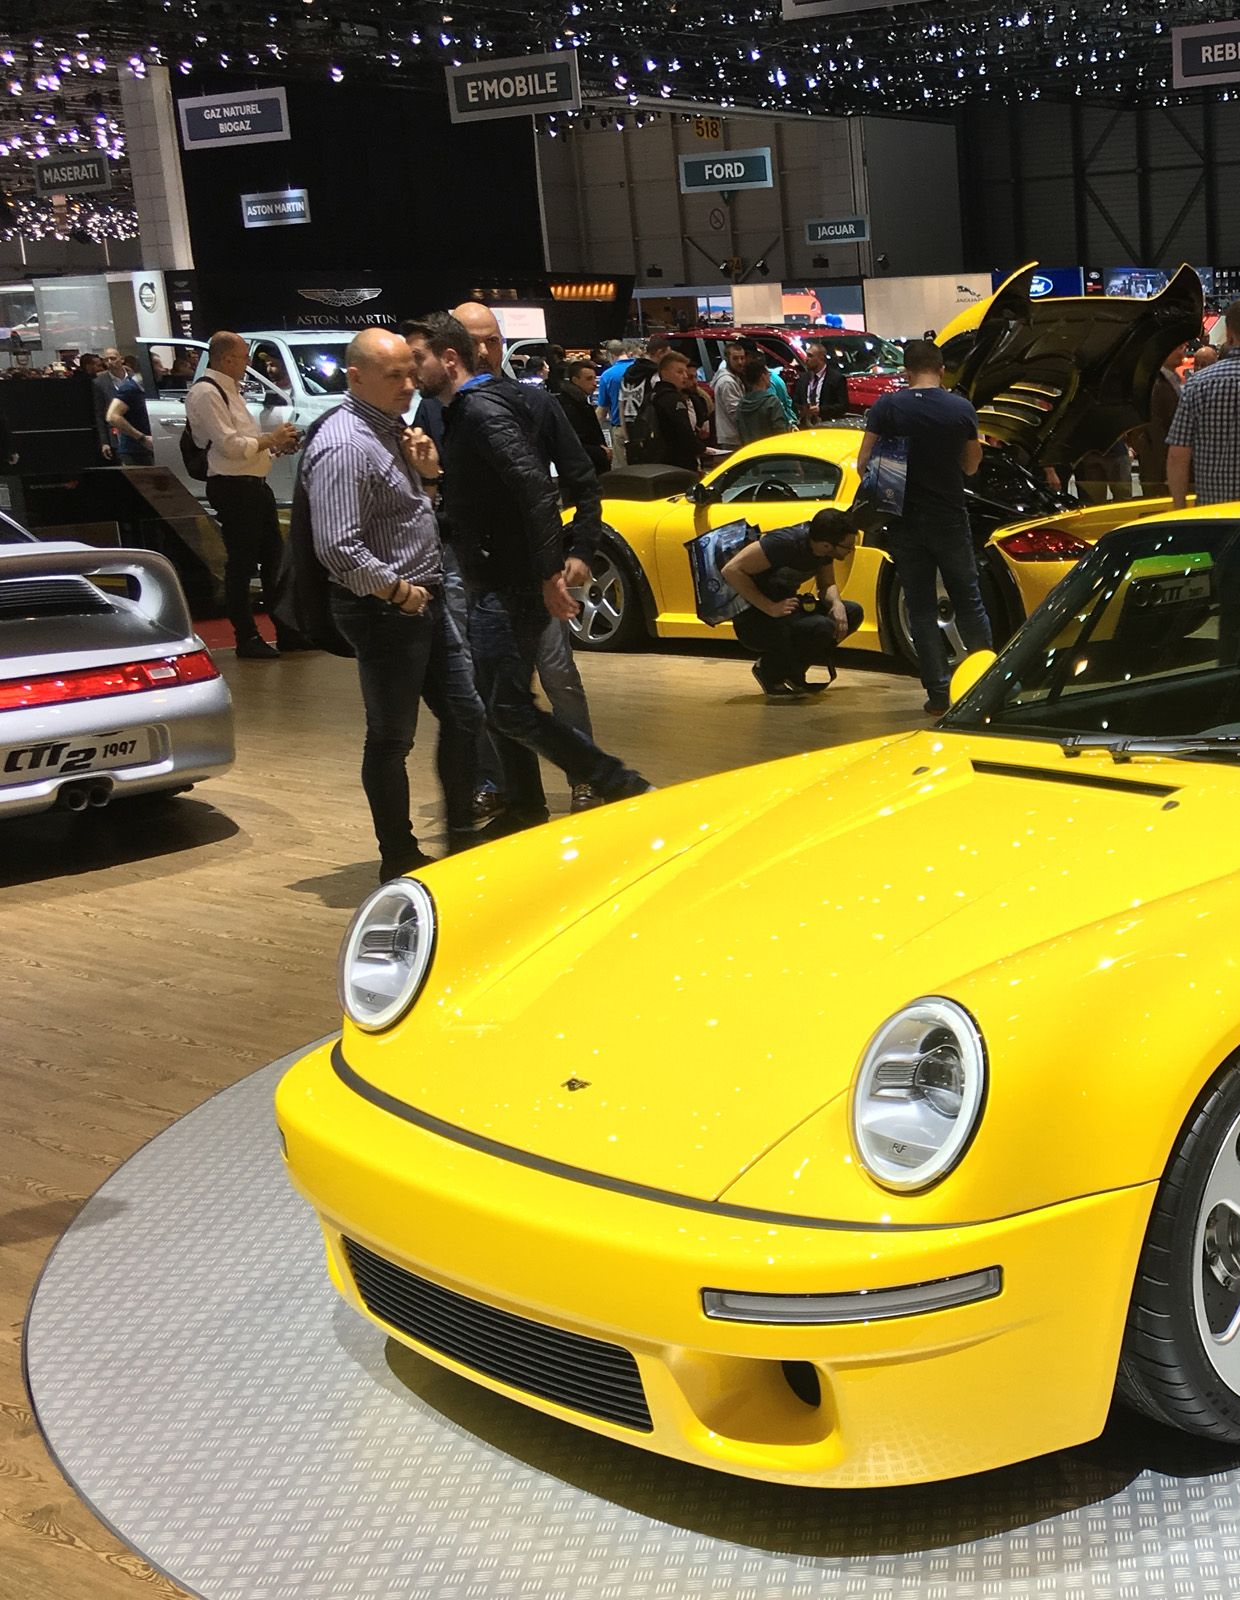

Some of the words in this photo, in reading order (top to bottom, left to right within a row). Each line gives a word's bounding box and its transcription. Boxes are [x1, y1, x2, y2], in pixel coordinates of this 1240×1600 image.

[466, 71, 558, 103] E'MOBILE
[203, 108, 222, 120] GAZ
[223, 103, 262, 118] NATUREL
[219, 120, 252, 134] BIOGAZ
[695, 120, 720, 139] 518
[43, 163, 99, 184] MASERATI
[704, 162, 745, 180] FORD
[247, 204, 273, 216] ASTON
[274, 201, 305, 214] MARTIN
[817, 223, 856, 239] JAGUAR
[297, 315, 339, 325] ASTON
[345, 314, 397, 324] MARTIN
[102, 740, 137, 758] 1997
